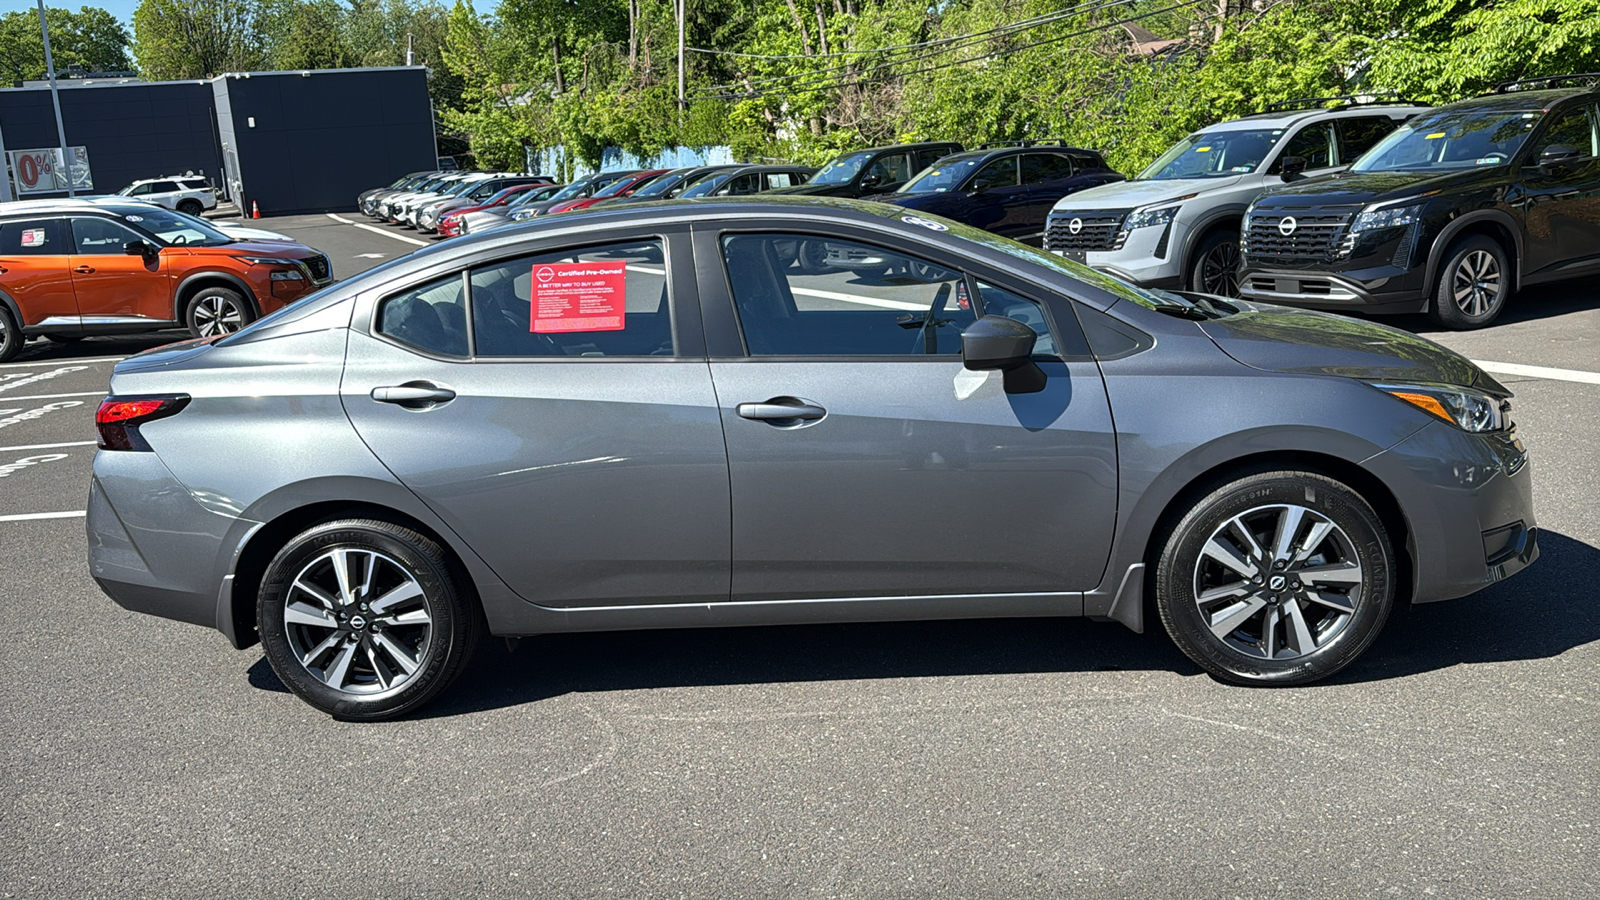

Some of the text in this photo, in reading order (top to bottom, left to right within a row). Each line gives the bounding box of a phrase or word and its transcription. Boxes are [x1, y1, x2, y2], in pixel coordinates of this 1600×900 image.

[19, 154, 51, 188] 0%
[1366, 540, 1385, 604] KUMHO
[416, 638, 447, 689] SOLUS
